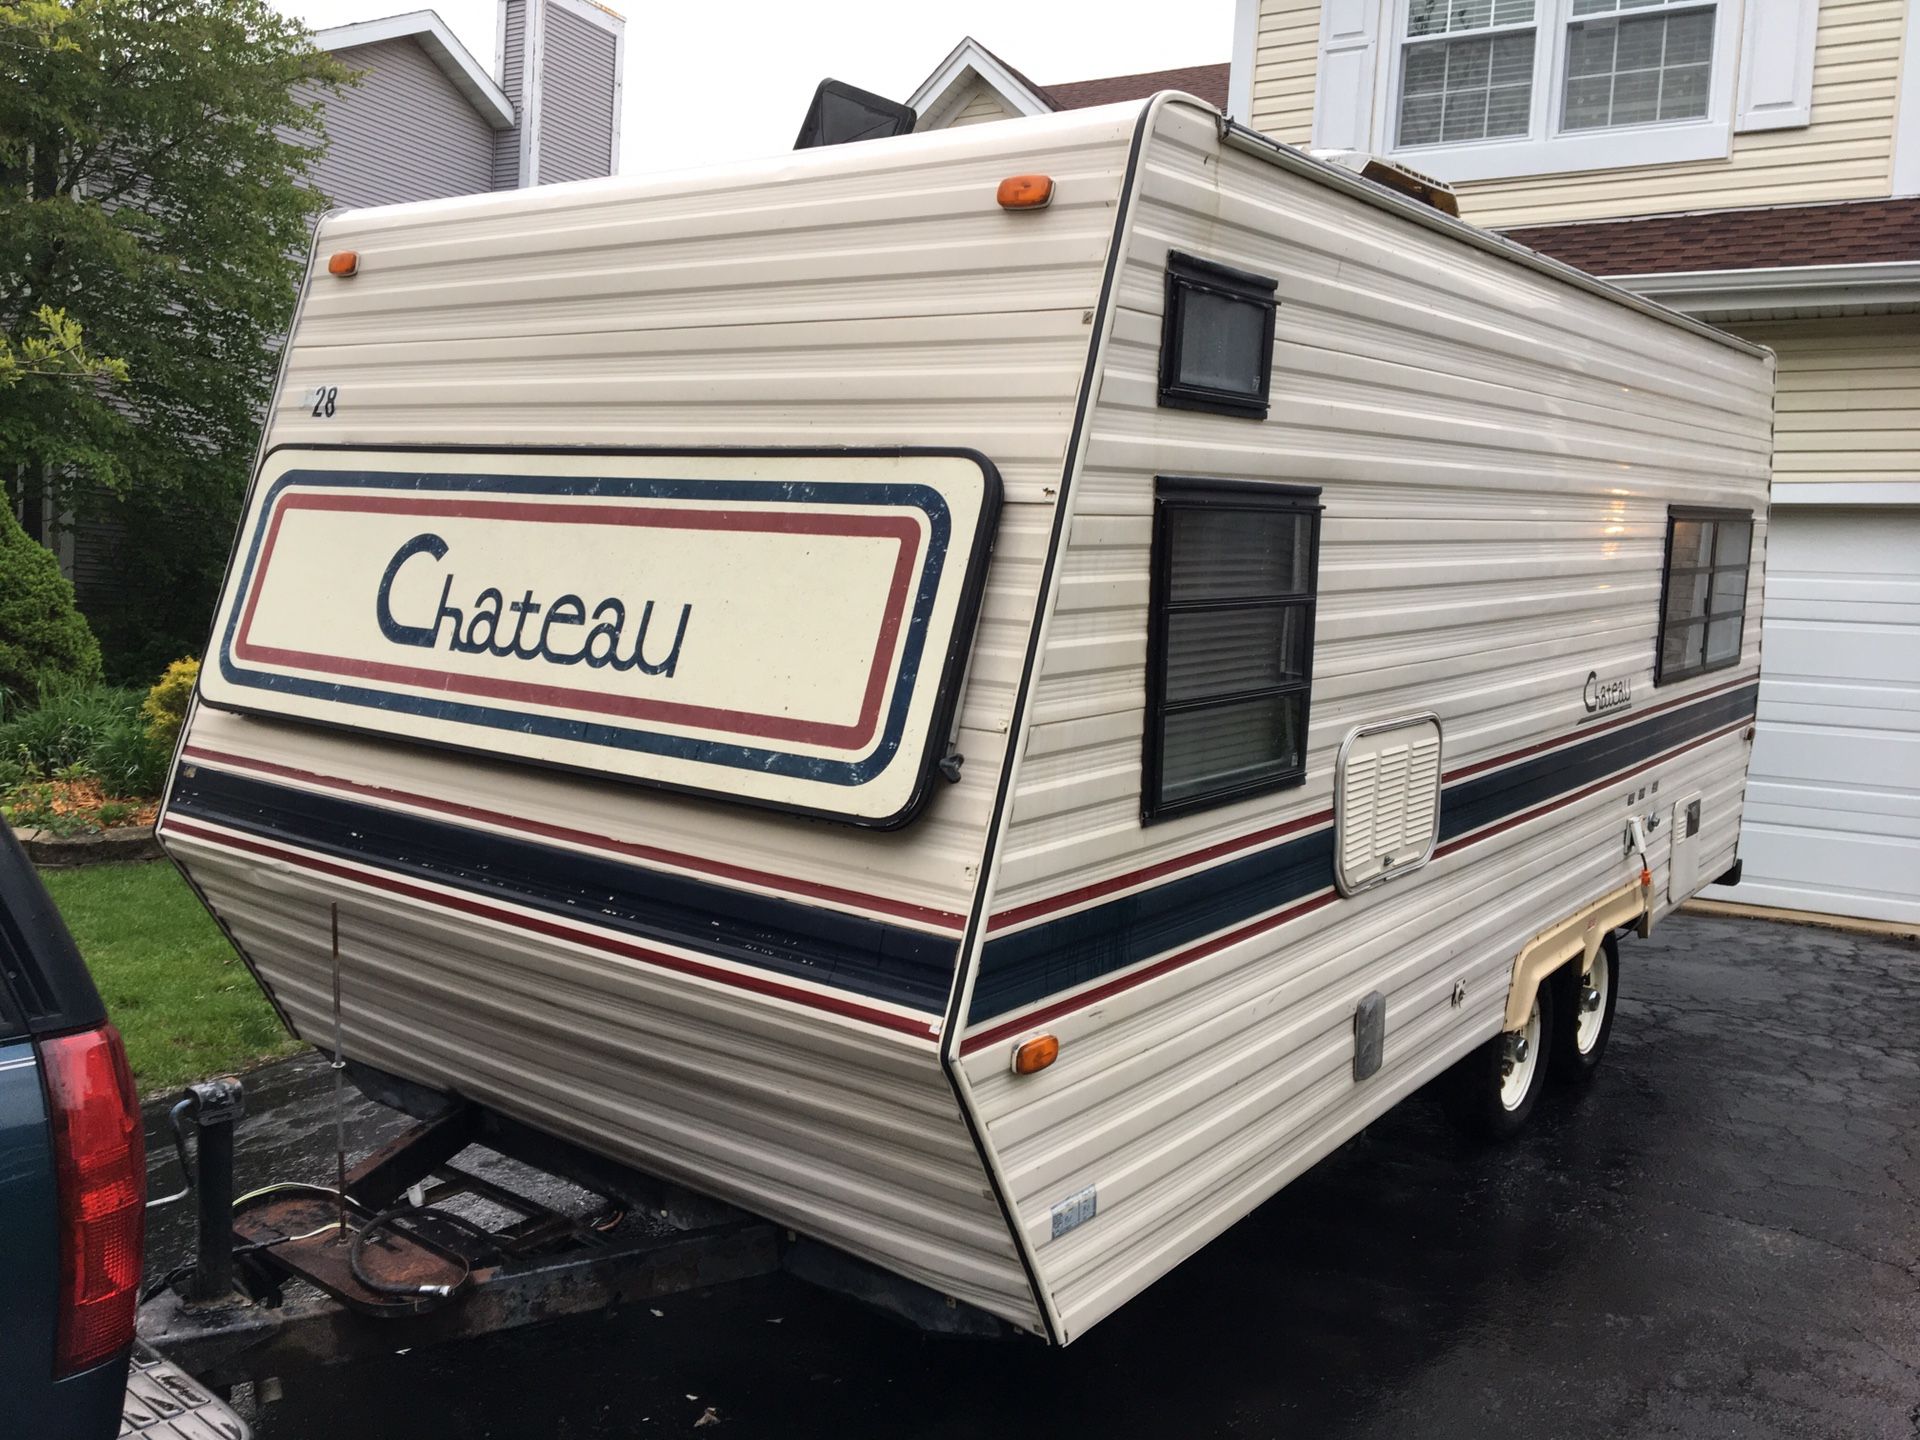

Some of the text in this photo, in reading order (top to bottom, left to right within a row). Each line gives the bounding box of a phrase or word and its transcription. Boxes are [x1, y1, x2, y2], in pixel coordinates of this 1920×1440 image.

[312, 386, 338, 418] 28
[376, 532, 693, 678] Chateau
[1583, 670, 1631, 713] Chateau
